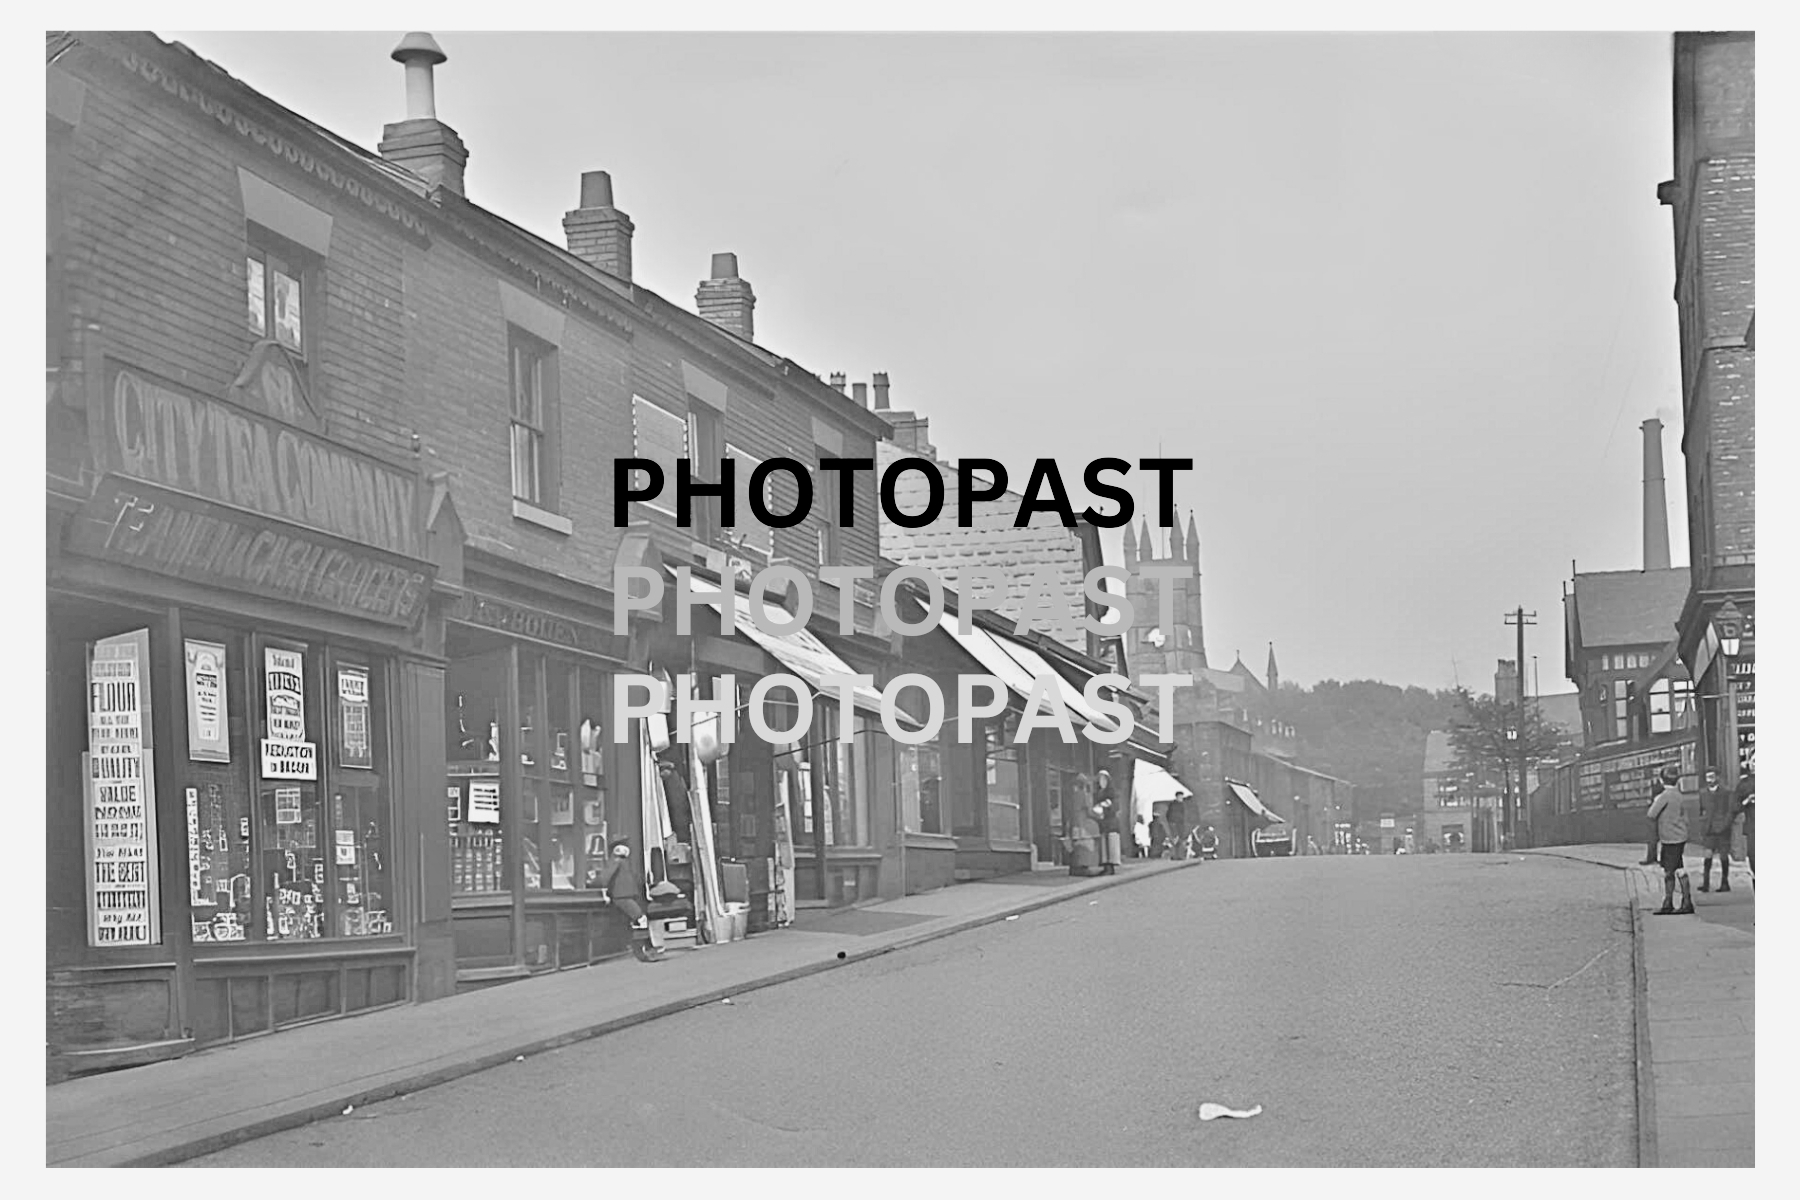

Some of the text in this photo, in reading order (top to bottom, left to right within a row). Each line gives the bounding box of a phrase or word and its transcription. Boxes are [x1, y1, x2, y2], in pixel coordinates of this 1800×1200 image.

[115, 370, 208, 491] CITY
[91, 682, 136, 712] FLOUR
[100, 785, 136, 802] VALUE
